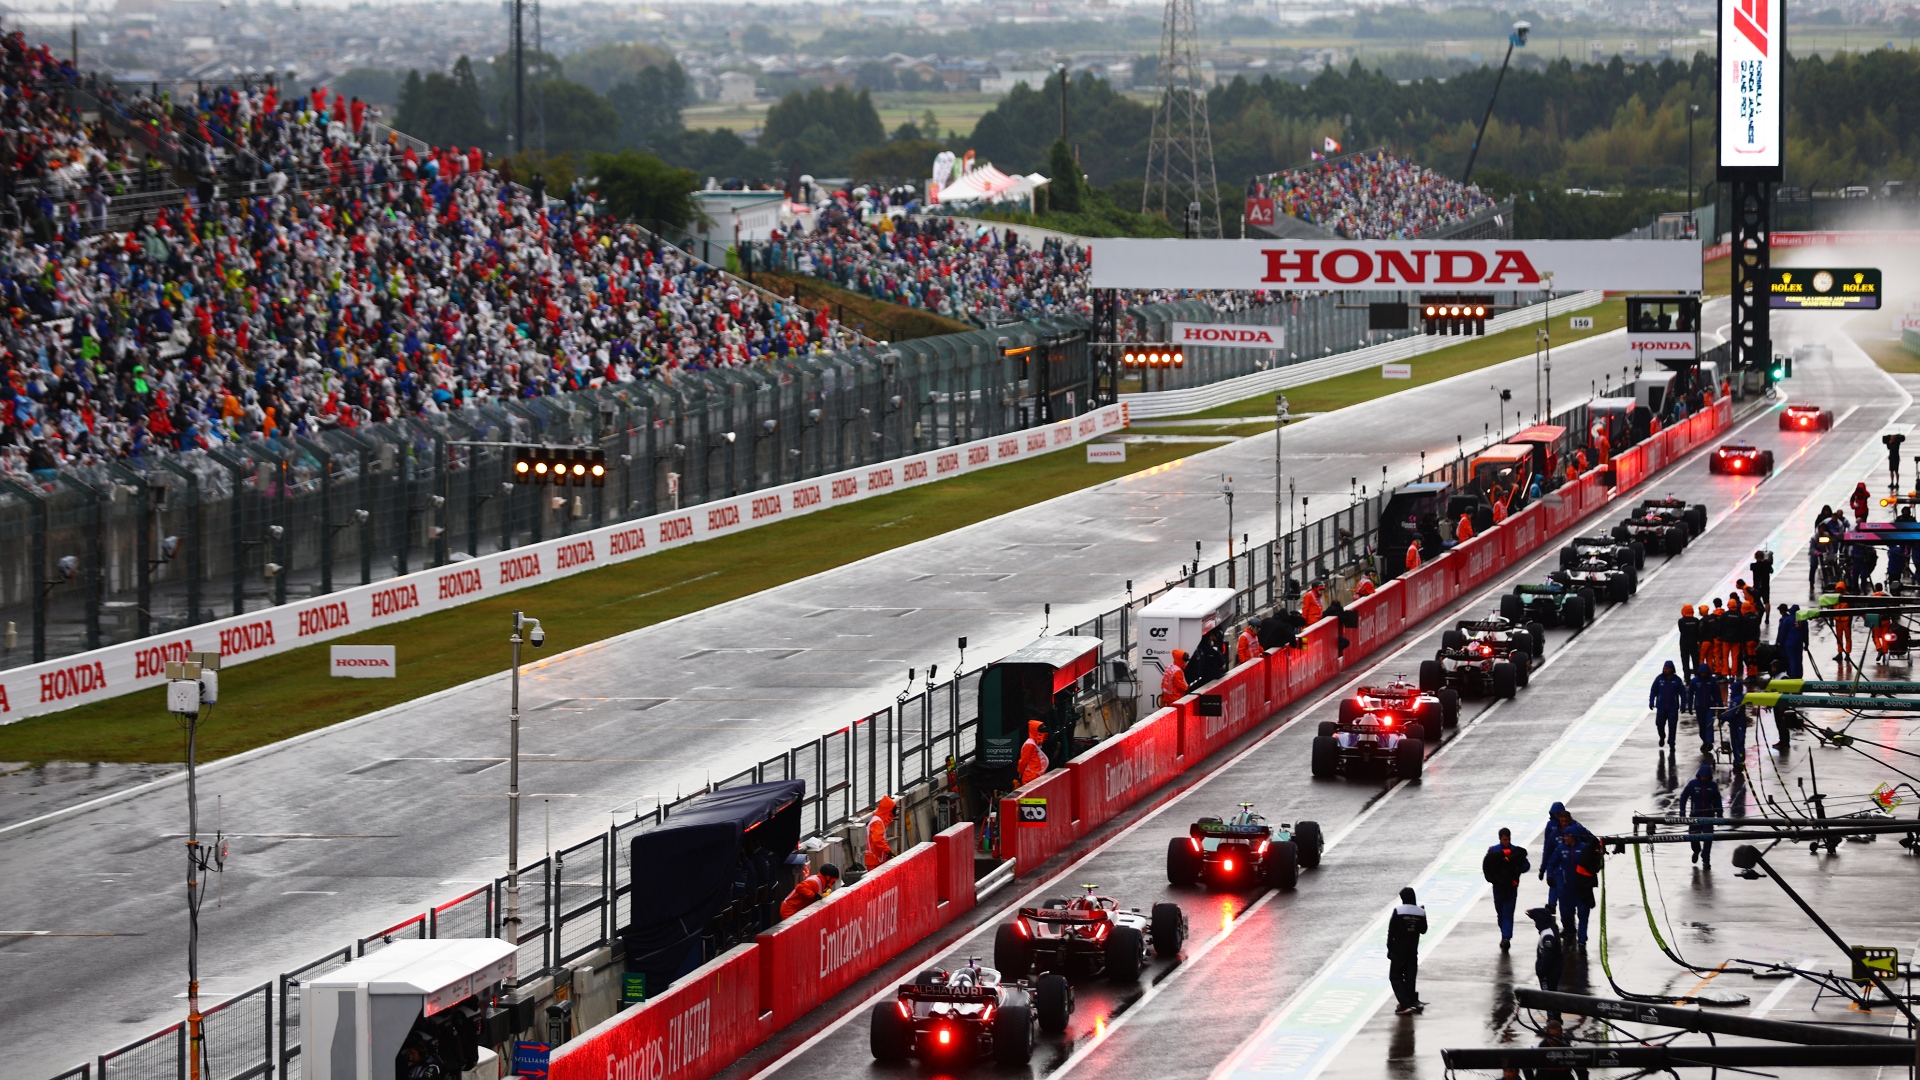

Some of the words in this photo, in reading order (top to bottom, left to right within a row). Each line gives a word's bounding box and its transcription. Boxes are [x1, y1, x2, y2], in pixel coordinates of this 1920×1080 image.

[1250, 204, 1271, 221] A2
[1772, 235, 1802, 245] Emirates
[1260, 249, 1539, 284] HONDA
[1771, 283, 1803, 292] ROLEX
[1843, 283, 1875, 292] ROLEX
[1574, 319, 1589, 327] 150
[1185, 329, 1272, 342] HONDA
[1632, 342, 1692, 350] HONDA
[968, 446, 990, 465] HONDA
[998, 439, 1018, 458] HONDA
[904, 461, 928, 482] HONDA
[937, 453, 959, 473] HONDA
[832, 478, 857, 498] HONDA
[868, 469, 894, 490] HONDA
[752, 496, 782, 519] HONDA
[793, 486, 821, 509] HONDA
[708, 505, 740, 530] HONDA
[660, 517, 693, 542] HONDA
[610, 528, 646, 555] HONDA
[557, 541, 595, 569] HONDA
[500, 554, 541, 584] HONDA
[439, 569, 482, 600] HONDA
[372, 584, 419, 617] HONDA
[299, 601, 350, 636] HONDA
[220, 620, 275, 657] HONDA
[335, 658, 390, 668] HONDA
[40, 661, 106, 702] HONDA
[1202, 825, 1258, 833] aramco
[1040, 910, 1057, 918] Alfa
[1060, 911, 1087, 919] Romeo
[820, 915, 863, 979] Emirates
[913, 985, 983, 996] ALPHATAURI
[668, 1014, 682, 1075] FLY
[683, 998, 710, 1066] BETTER
[514, 1056, 549, 1064] WILLIAMS
